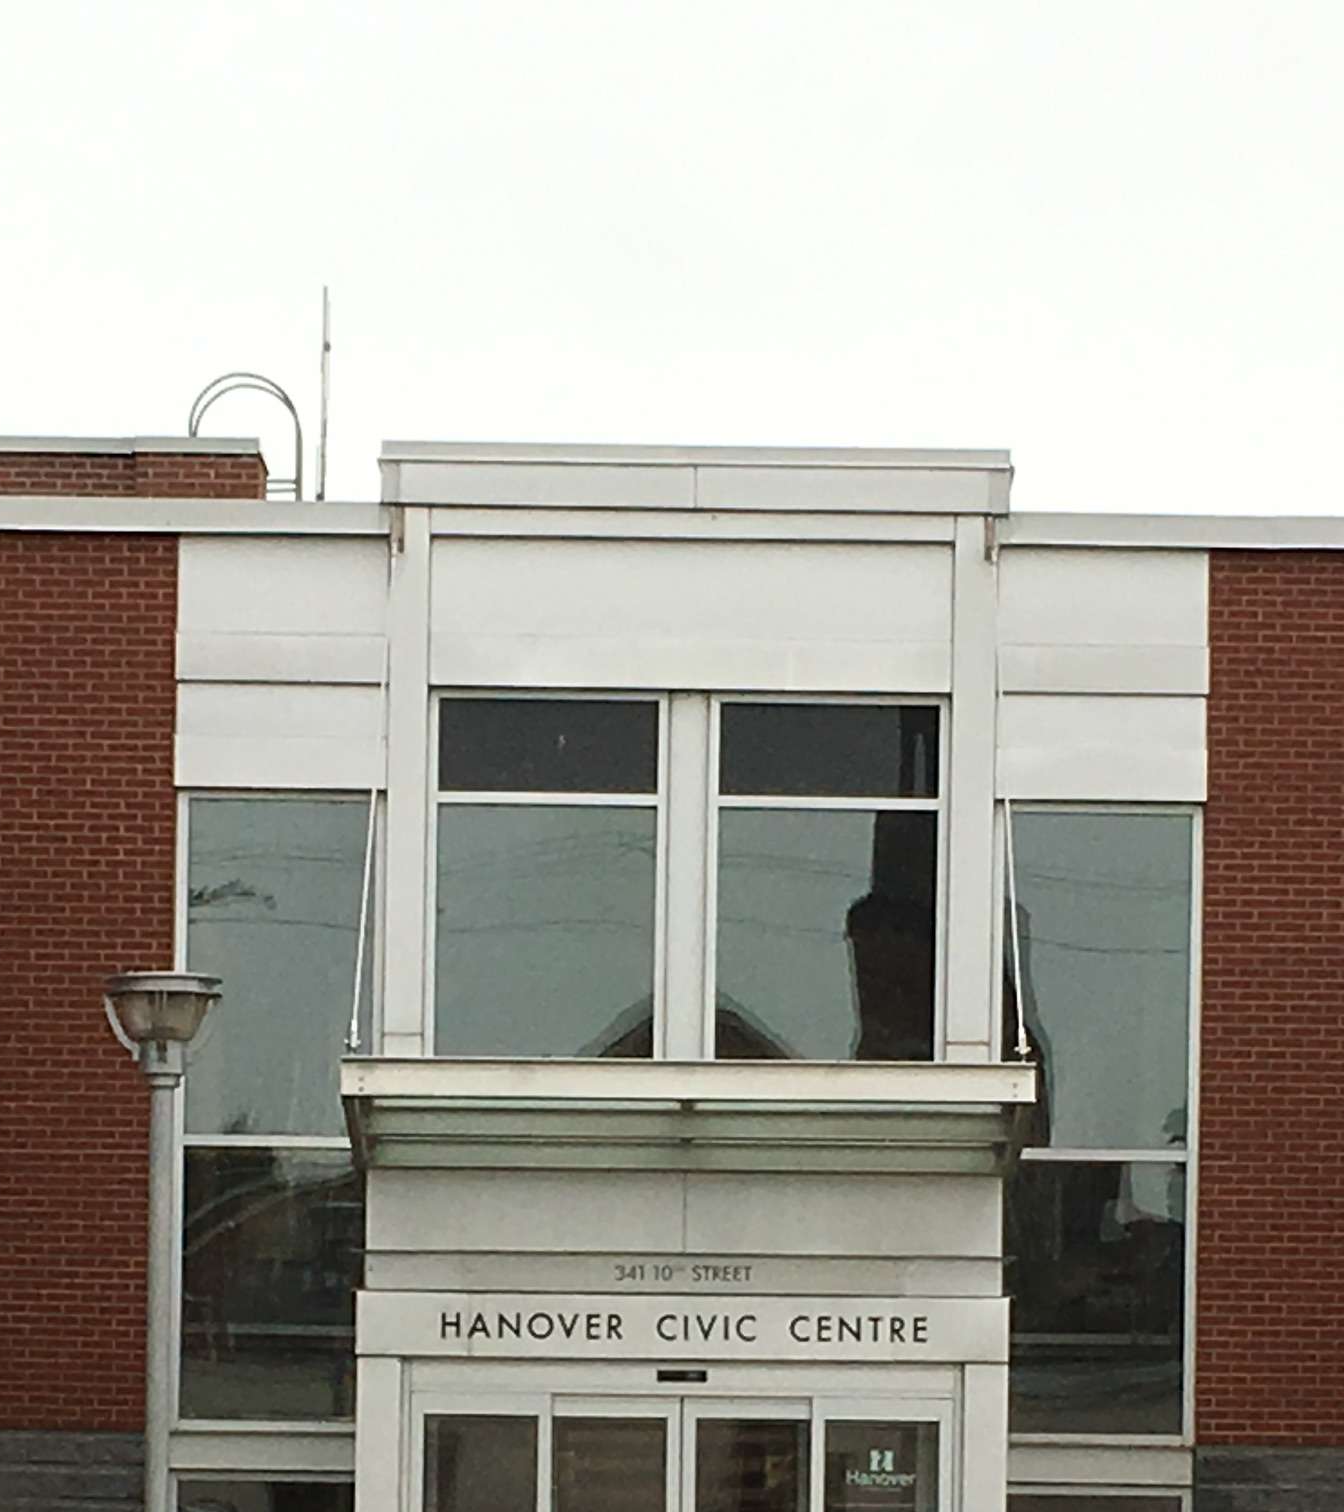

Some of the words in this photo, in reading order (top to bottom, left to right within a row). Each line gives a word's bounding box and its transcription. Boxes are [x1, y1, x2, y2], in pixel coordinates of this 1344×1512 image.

[613, 1264, 645, 1282] 341
[691, 1264, 753, 1283] STREET
[439, 1311, 624, 1342] HANOVER
[655, 1313, 758, 1343] CIVIC
[788, 1315, 930, 1345] CENTRE
[845, 1469, 917, 1487] Hanover
